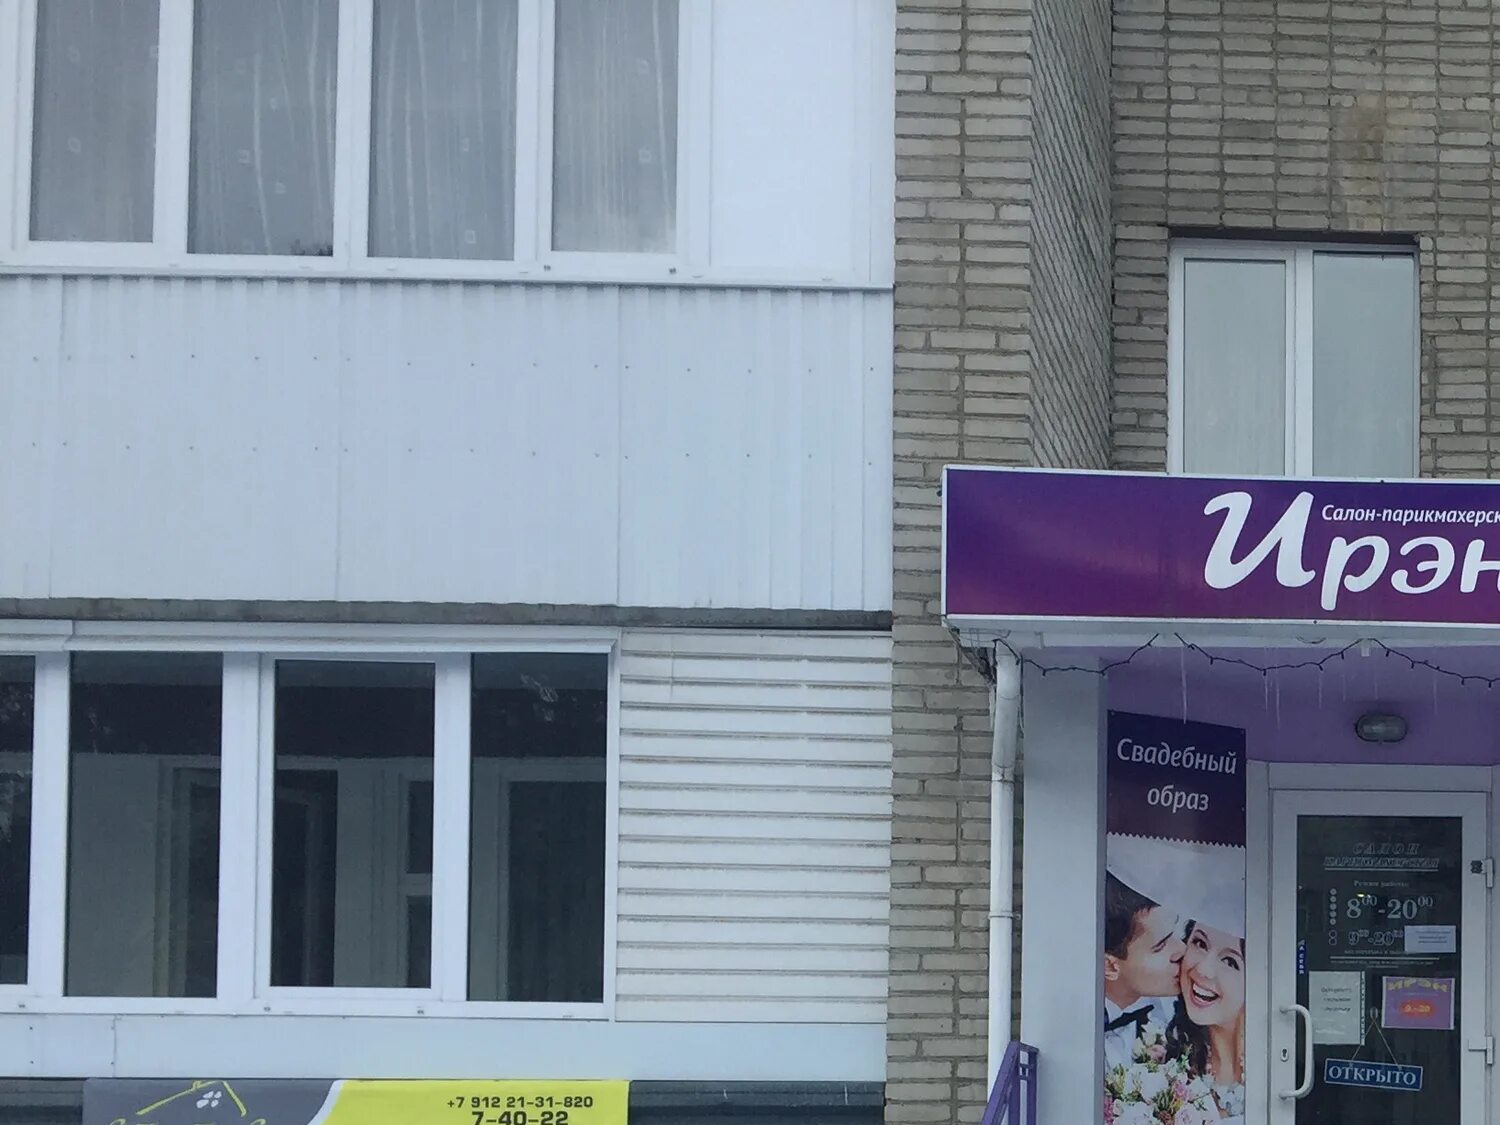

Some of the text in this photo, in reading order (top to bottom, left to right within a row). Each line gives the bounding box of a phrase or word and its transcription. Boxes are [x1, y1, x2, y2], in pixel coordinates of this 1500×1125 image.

[1116, 737, 1238, 775] Свадебный
[1147, 784, 1210, 814] образ
[1328, 1065, 1417, 1086] ОТКРЫТО
[447, 1096, 594, 1108] +7 912 21-31-820
